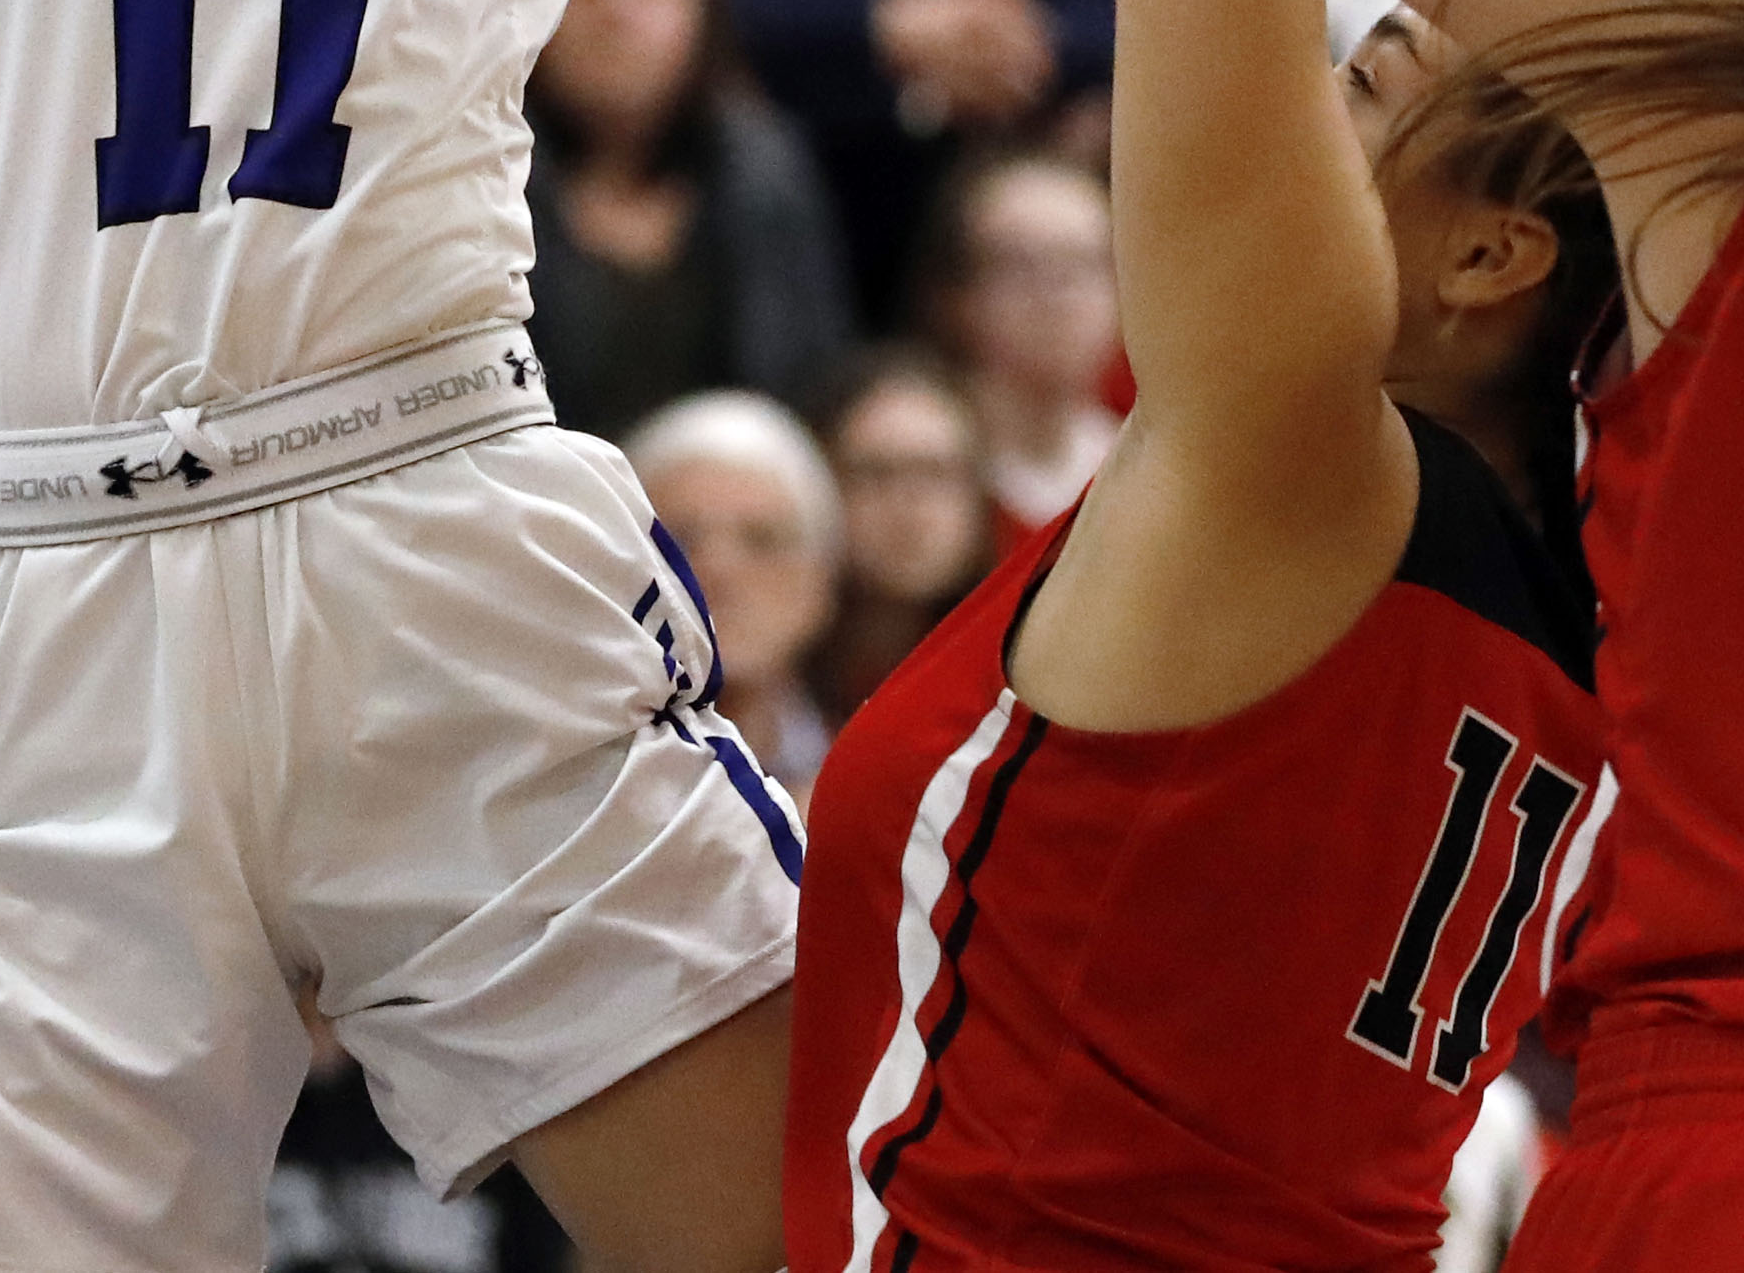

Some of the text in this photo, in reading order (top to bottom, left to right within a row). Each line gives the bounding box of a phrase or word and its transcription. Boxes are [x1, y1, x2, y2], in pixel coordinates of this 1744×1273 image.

[230, 364, 501, 466] UNDER ARMOUR
[1345, 706, 1586, 1094] 11
